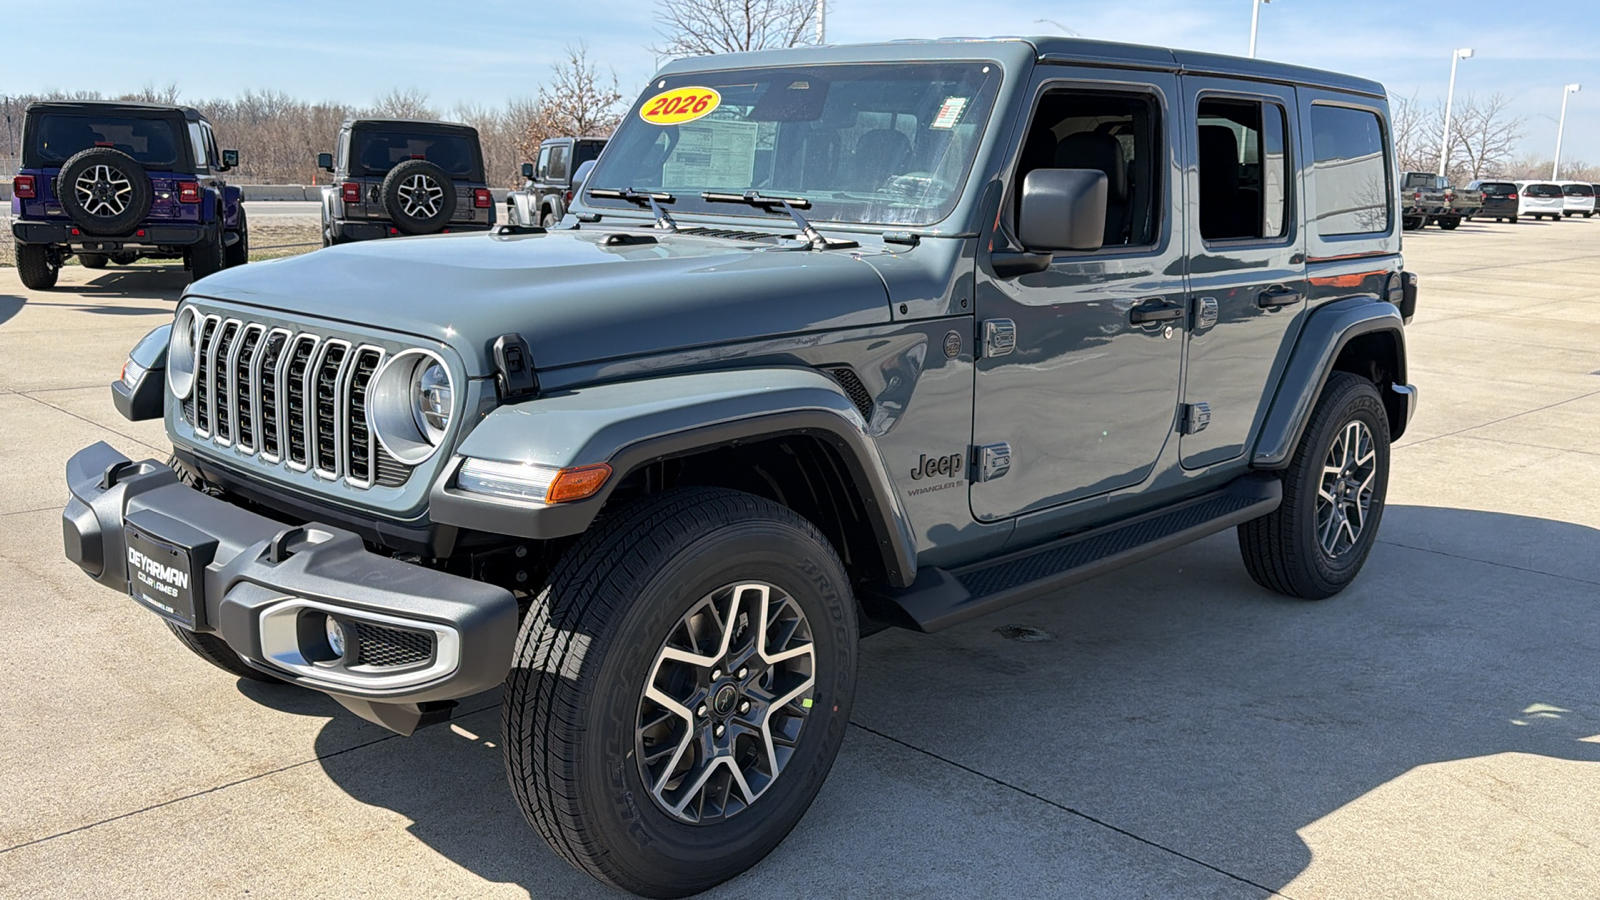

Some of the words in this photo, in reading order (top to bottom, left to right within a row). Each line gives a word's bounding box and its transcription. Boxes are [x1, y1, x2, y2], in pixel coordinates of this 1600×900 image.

[645, 94, 713, 117] 2026
[910, 453, 963, 481] Jeep
[907, 481, 955, 497] WRANGLER
[128, 546, 188, 589] DEYARMAN
